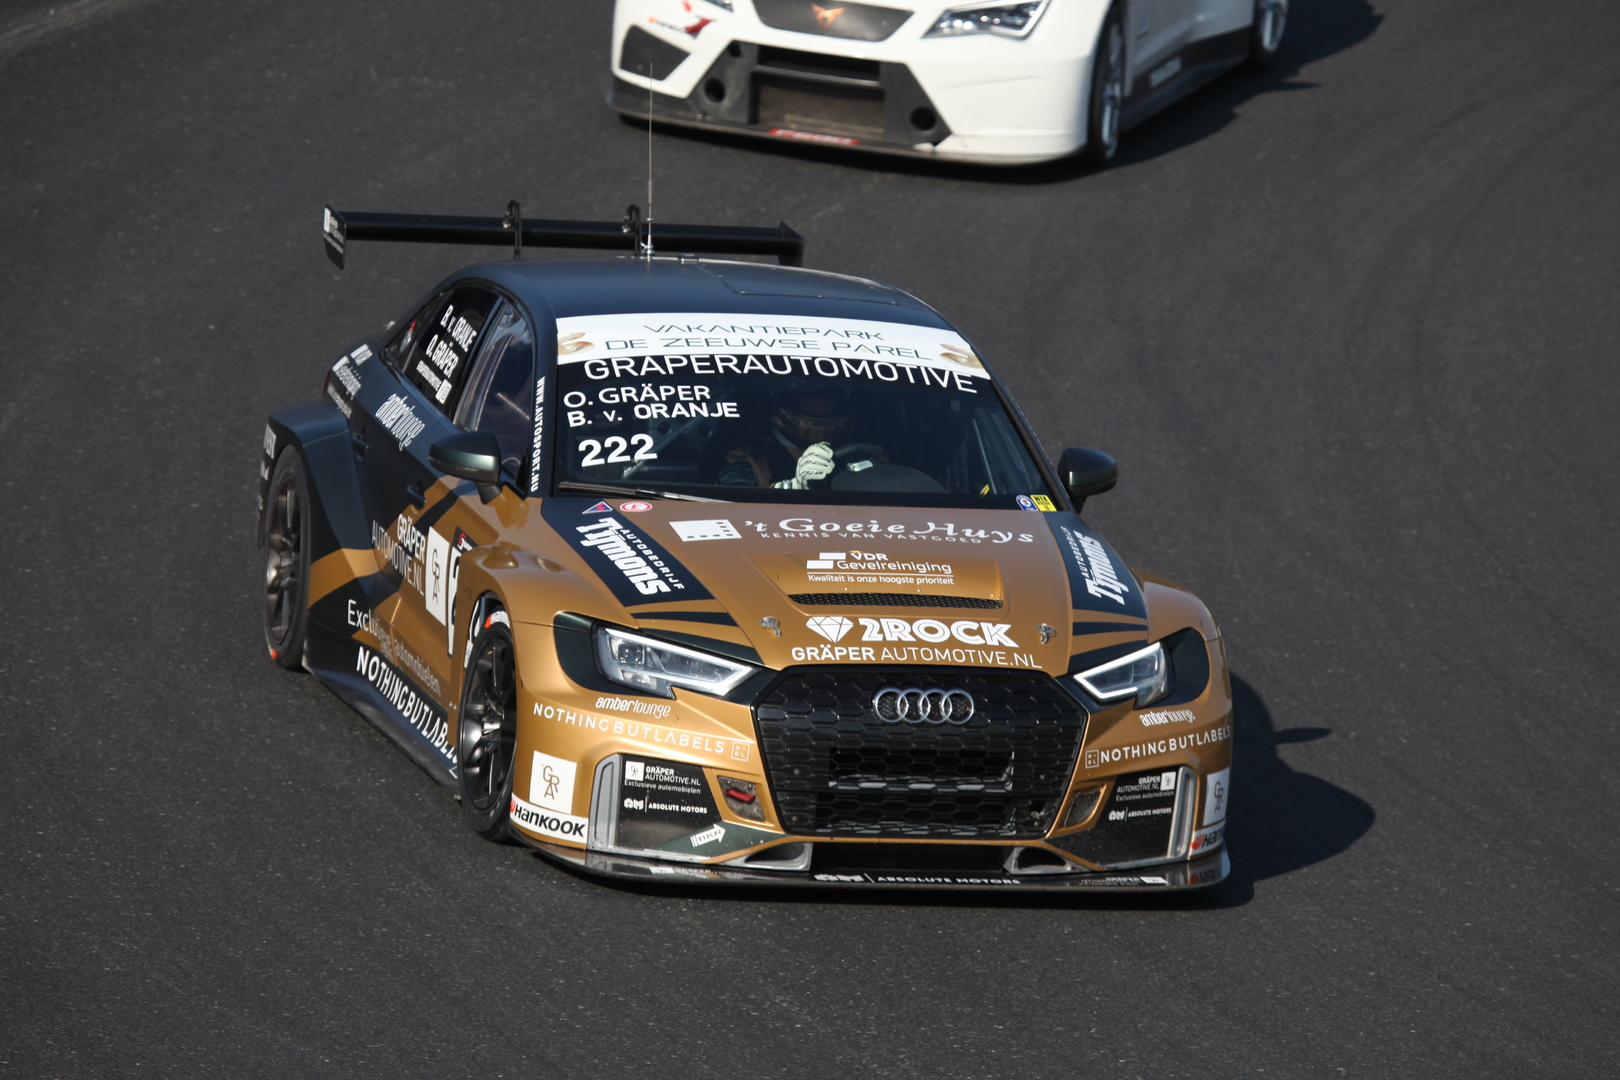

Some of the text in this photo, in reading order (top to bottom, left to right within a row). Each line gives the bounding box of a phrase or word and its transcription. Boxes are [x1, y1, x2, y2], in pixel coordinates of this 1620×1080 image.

[643, 324, 885, 341] VAKANTIEPARK
[605, 337, 933, 361] DE ZEEUWSE PAREL
[584, 354, 978, 394] GRAPERAUTOMOTIVE
[563, 383, 711, 408] O. GRÄPER
[567, 402, 740, 428] B. v. ORANJE
[578, 433, 658, 467] 222
[397, 513, 426, 565] GRÄPER
[779, 518, 905, 533] Goeie
[913, 521, 1034, 544] Huys
[884, 533, 982, 544] VASTGOED
[619, 528, 685, 590] AUTOBEDRIJF
[837, 560, 952, 575] Gevelreiniging
[850, 552, 889, 561] VDR
[807, 574, 954, 585] Kwaliteit is onze hoogste prioriteit
[858, 617, 1020, 648] 2ROCK
[791, 643, 1043, 670] GRÄPER AUTOMOTIVE.NL
[595, 696, 671, 719] amberlounge
[1139, 708, 1196, 727] amberlounge
[533, 702, 726, 754] NOTHINGBUTLABELS
[1100, 724, 1231, 764] NOTHINGBUTLABELS
[624, 780, 701, 795] Exclusieve automobielen
[644, 773, 701, 786] AUTOMOTIVE.NL
[648, 802, 680, 812] ABSOLUTE
[680, 805, 708, 814] MOTORS
[877, 876, 952, 884] ABSOLUTE
[956, 877, 1021, 885] MOTORS
